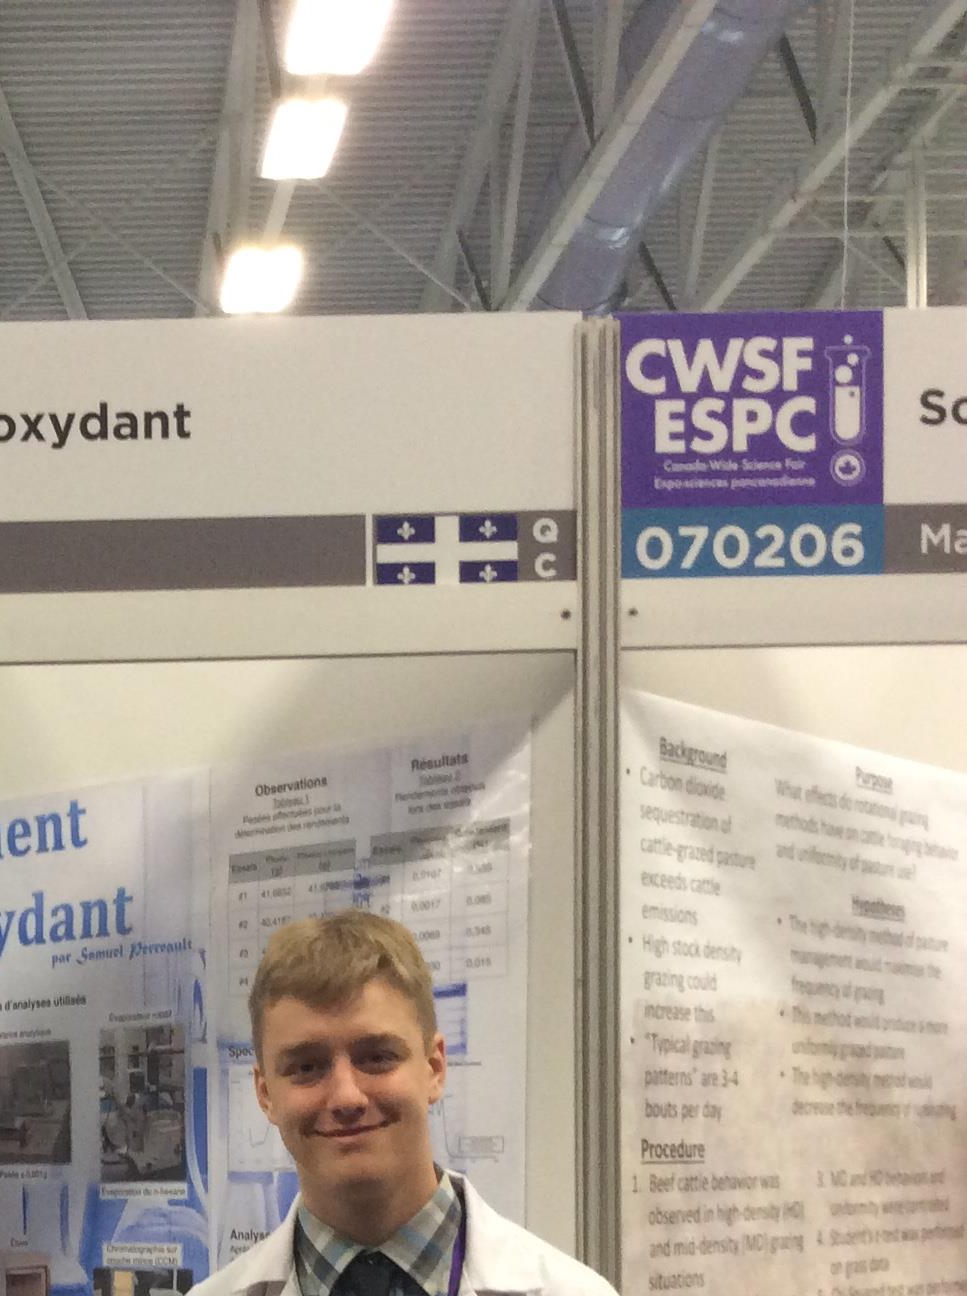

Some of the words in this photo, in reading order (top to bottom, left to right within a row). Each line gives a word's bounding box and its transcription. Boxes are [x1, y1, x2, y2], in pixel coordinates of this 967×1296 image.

[625, 337, 815, 395] CWSF
[653, 396, 817, 454] ESPC
[634, 522, 865, 571] 070206
[255, 776, 328, 797] Observations
[640, 1138, 706, 1162] Procedure
